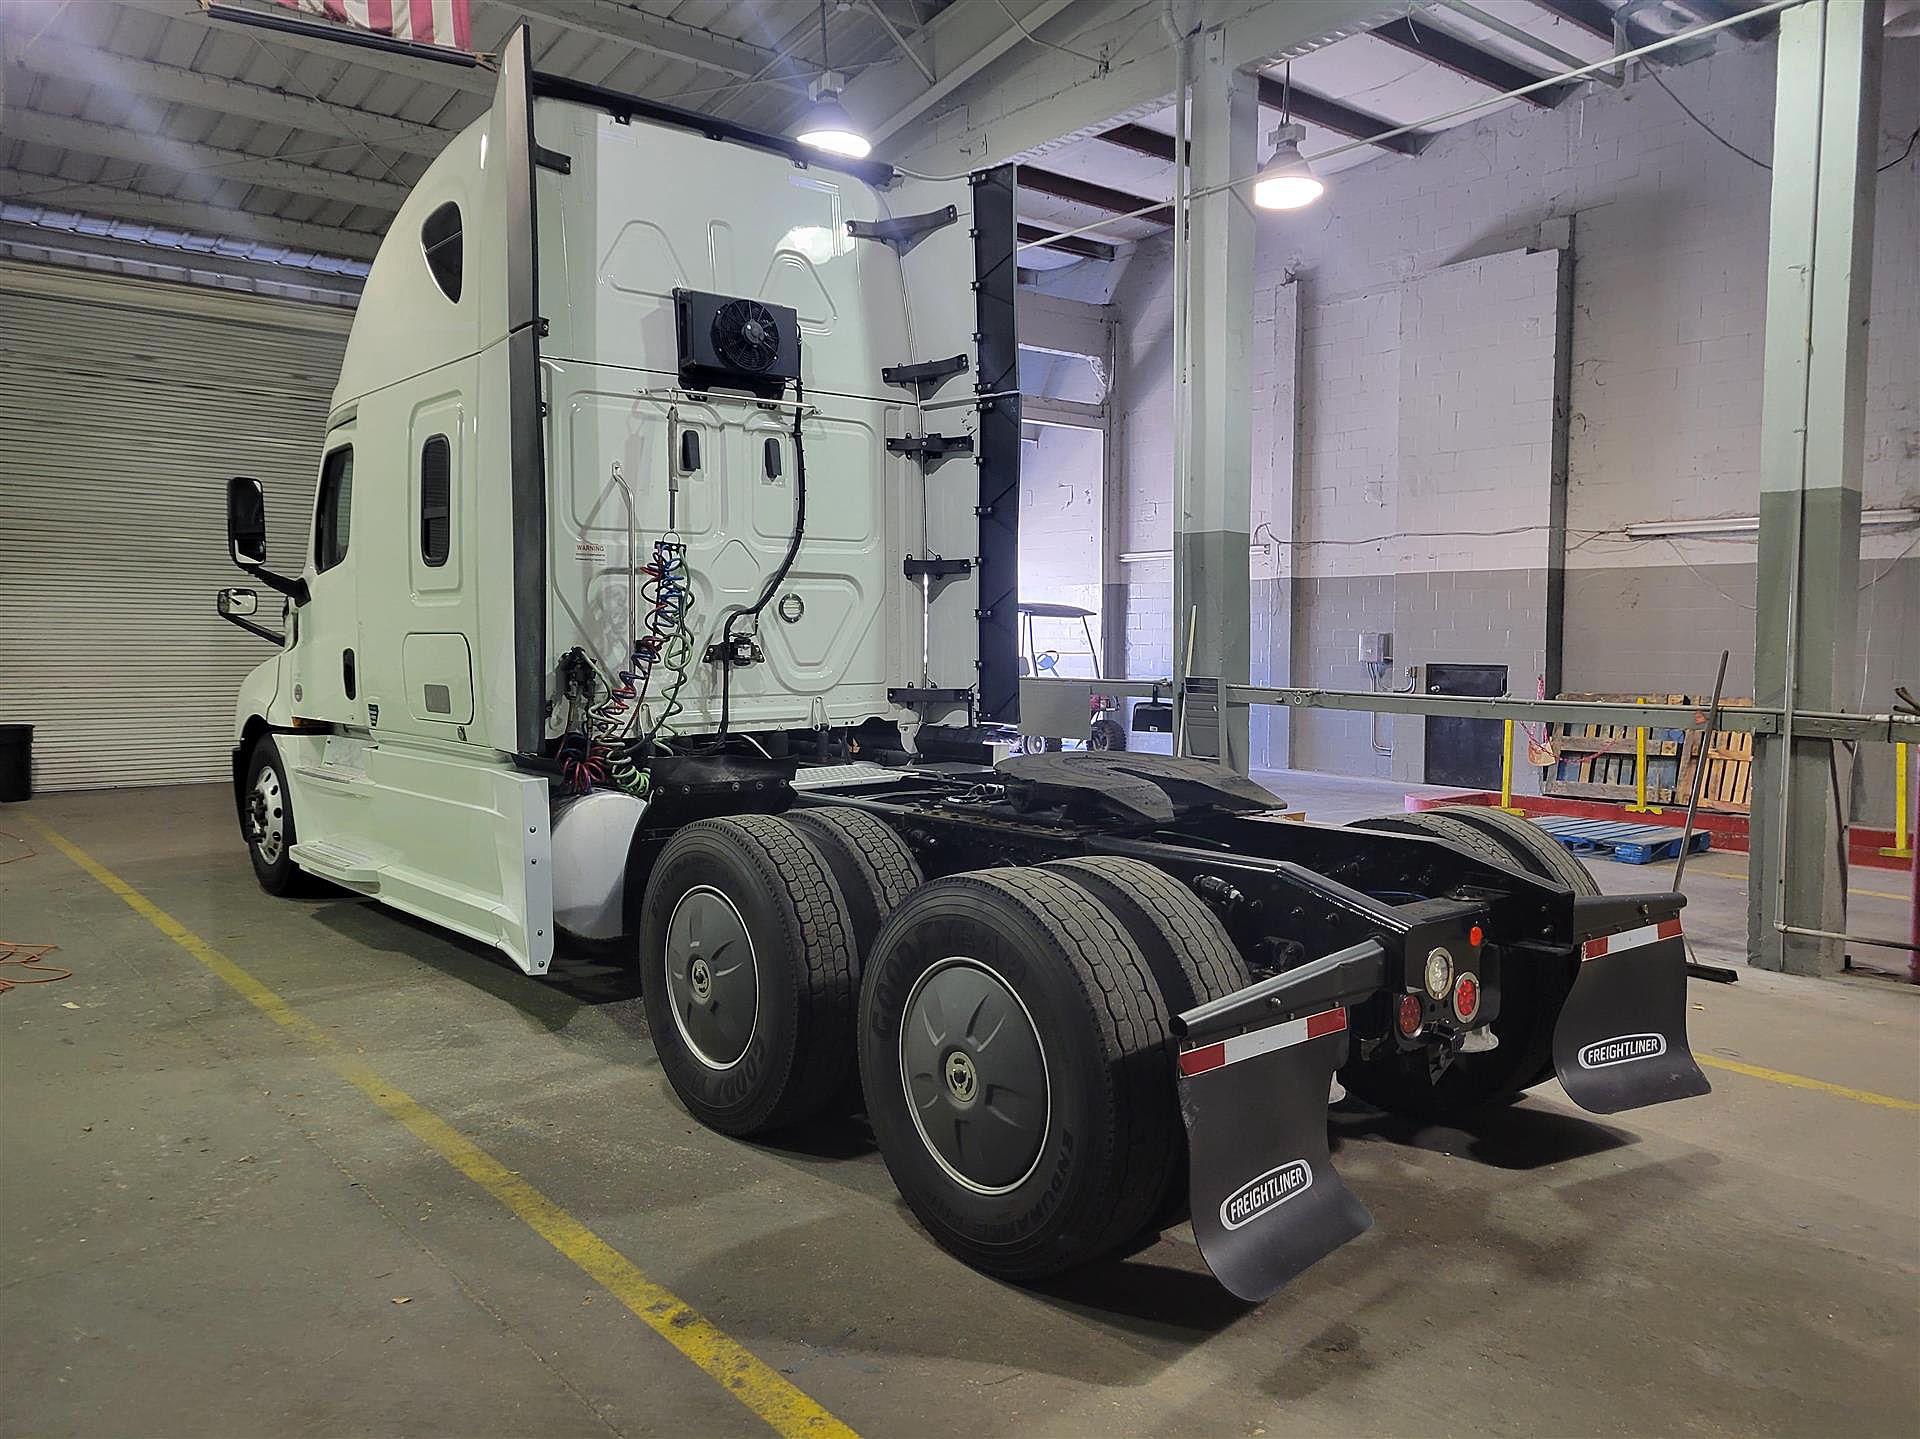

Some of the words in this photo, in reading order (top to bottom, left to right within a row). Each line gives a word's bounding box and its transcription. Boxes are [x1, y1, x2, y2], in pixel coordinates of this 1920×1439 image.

[576, 544, 605, 552] WARNING
[1588, 1038, 1659, 1064] FREIGHTLINER
[1230, 1167, 1304, 1222] FREIGHTLINER
